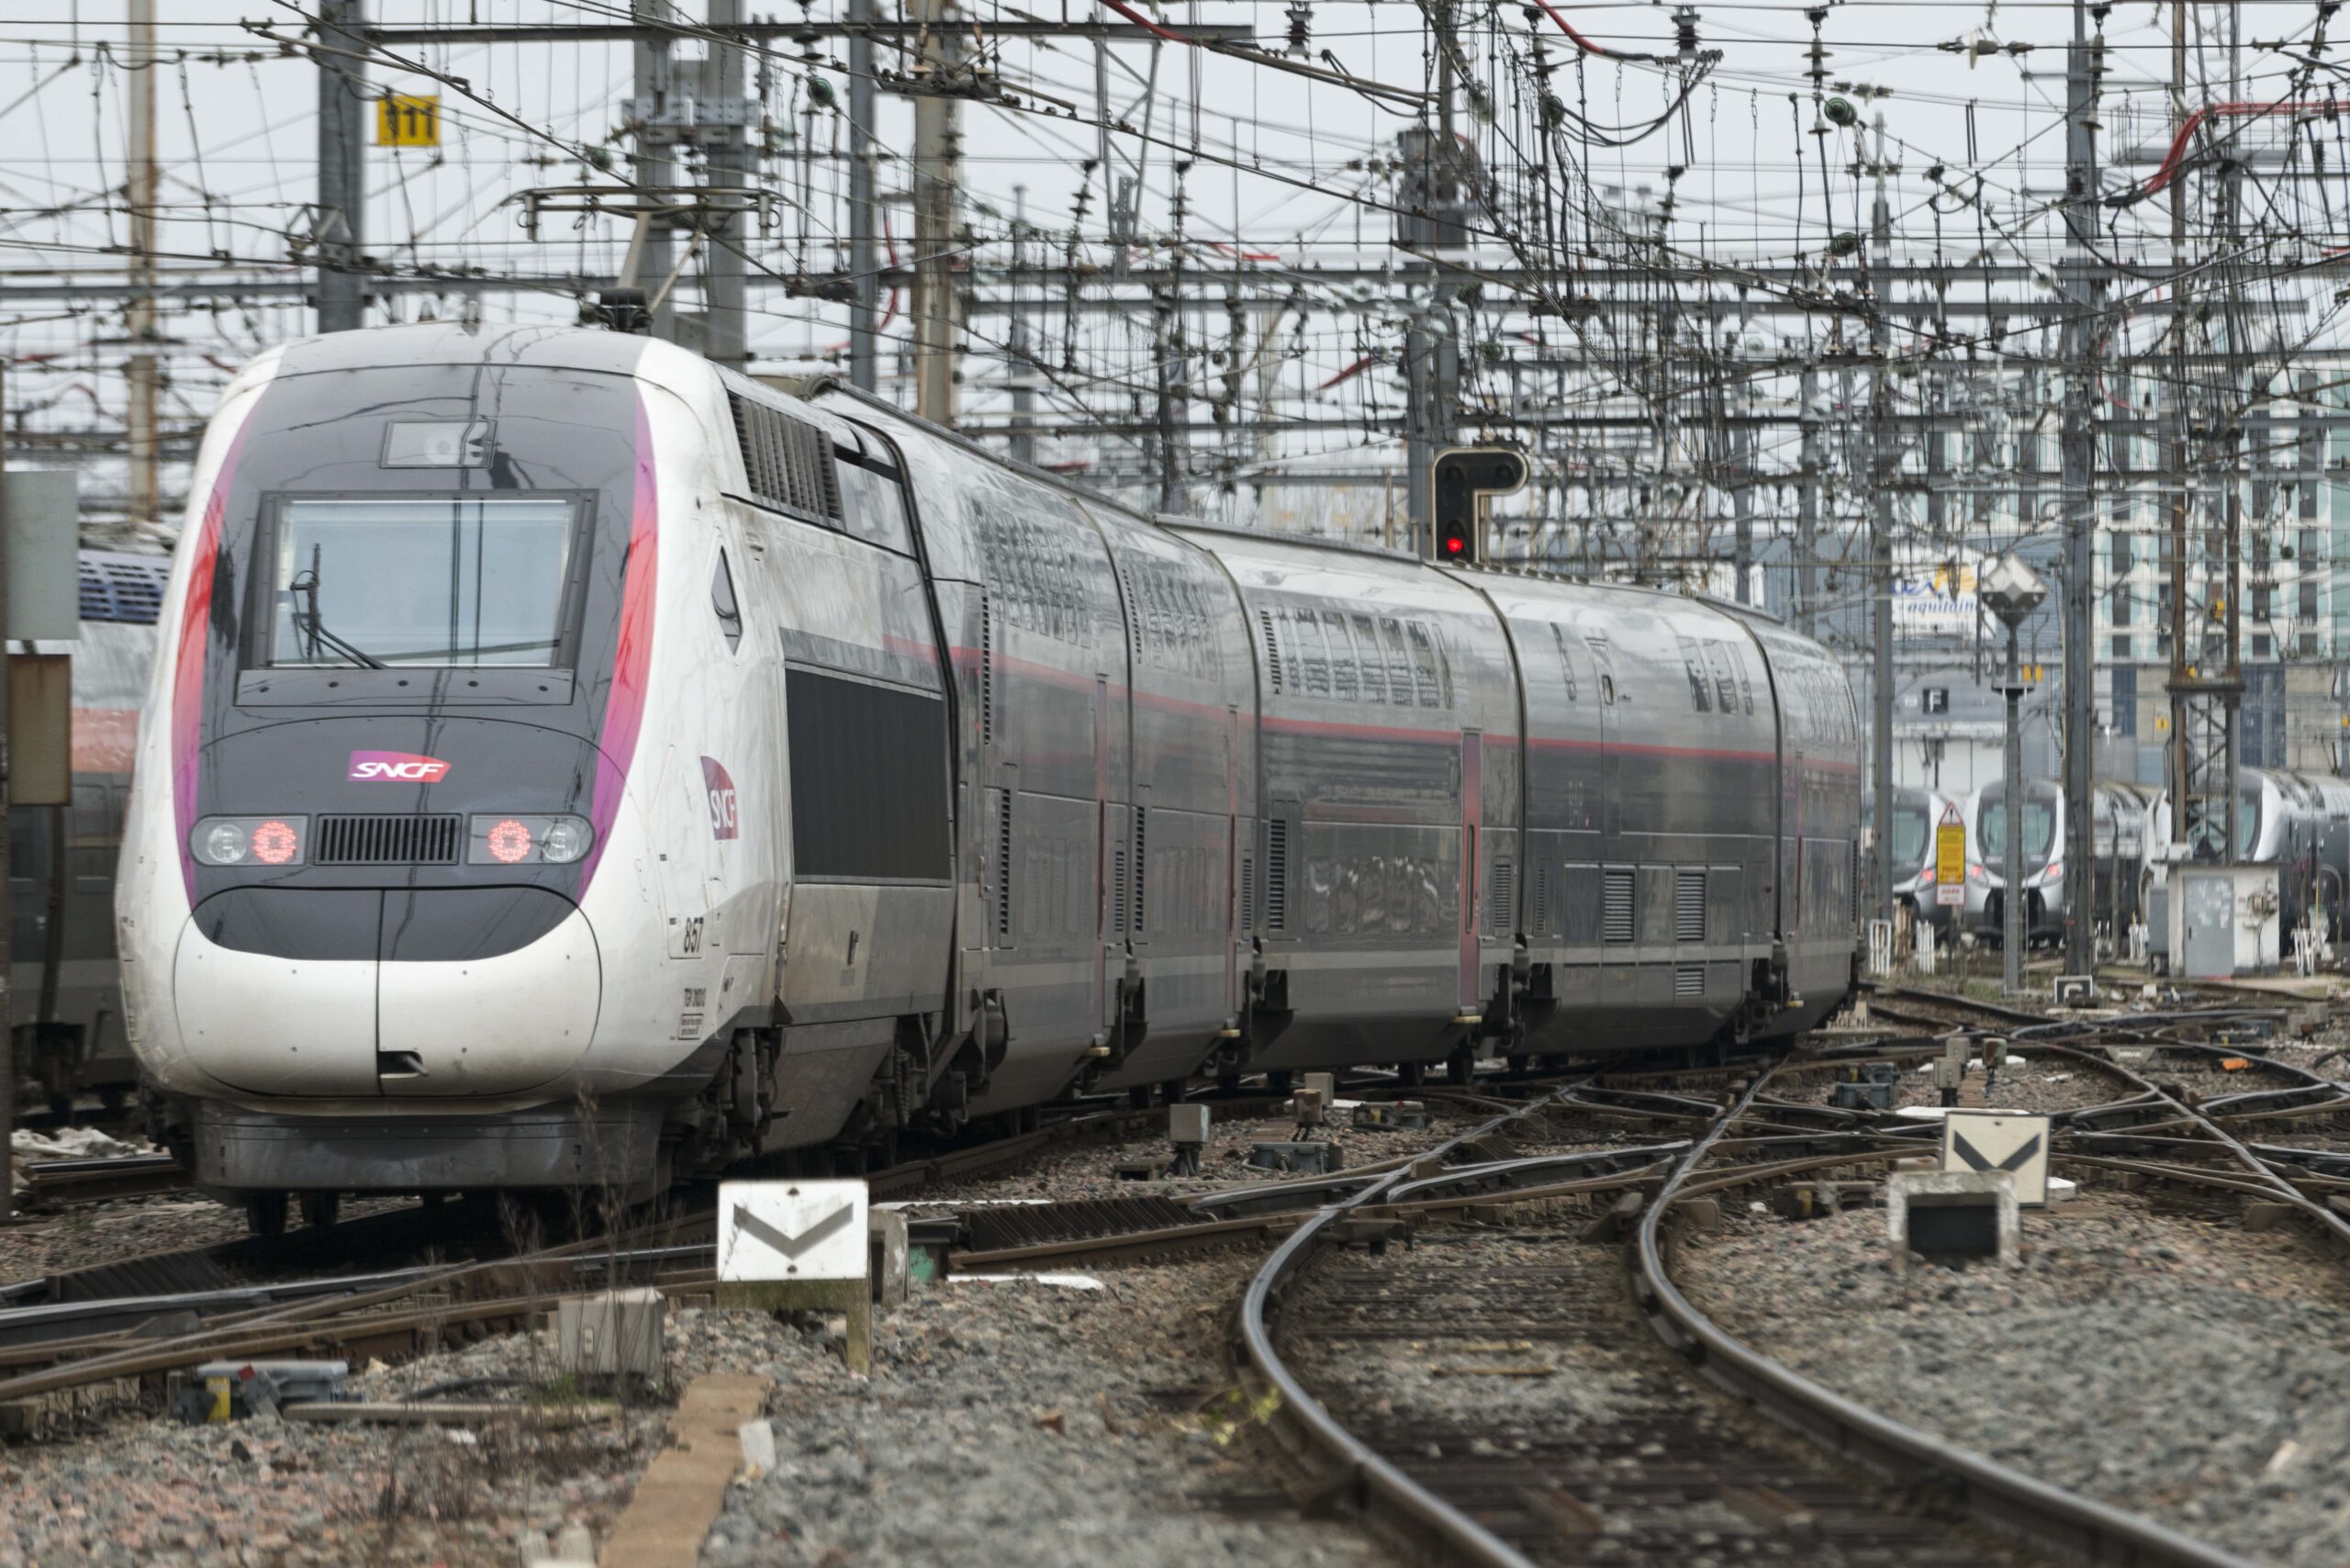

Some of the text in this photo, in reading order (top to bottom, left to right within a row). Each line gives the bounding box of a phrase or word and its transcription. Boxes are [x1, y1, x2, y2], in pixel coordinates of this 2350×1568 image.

[1908, 598, 1977, 617] aquitain
[1930, 690, 1942, 712] F
[352, 763, 444, 778] SNCF
[710, 790, 735, 829] SNCF
[684, 917, 704, 953] 857
